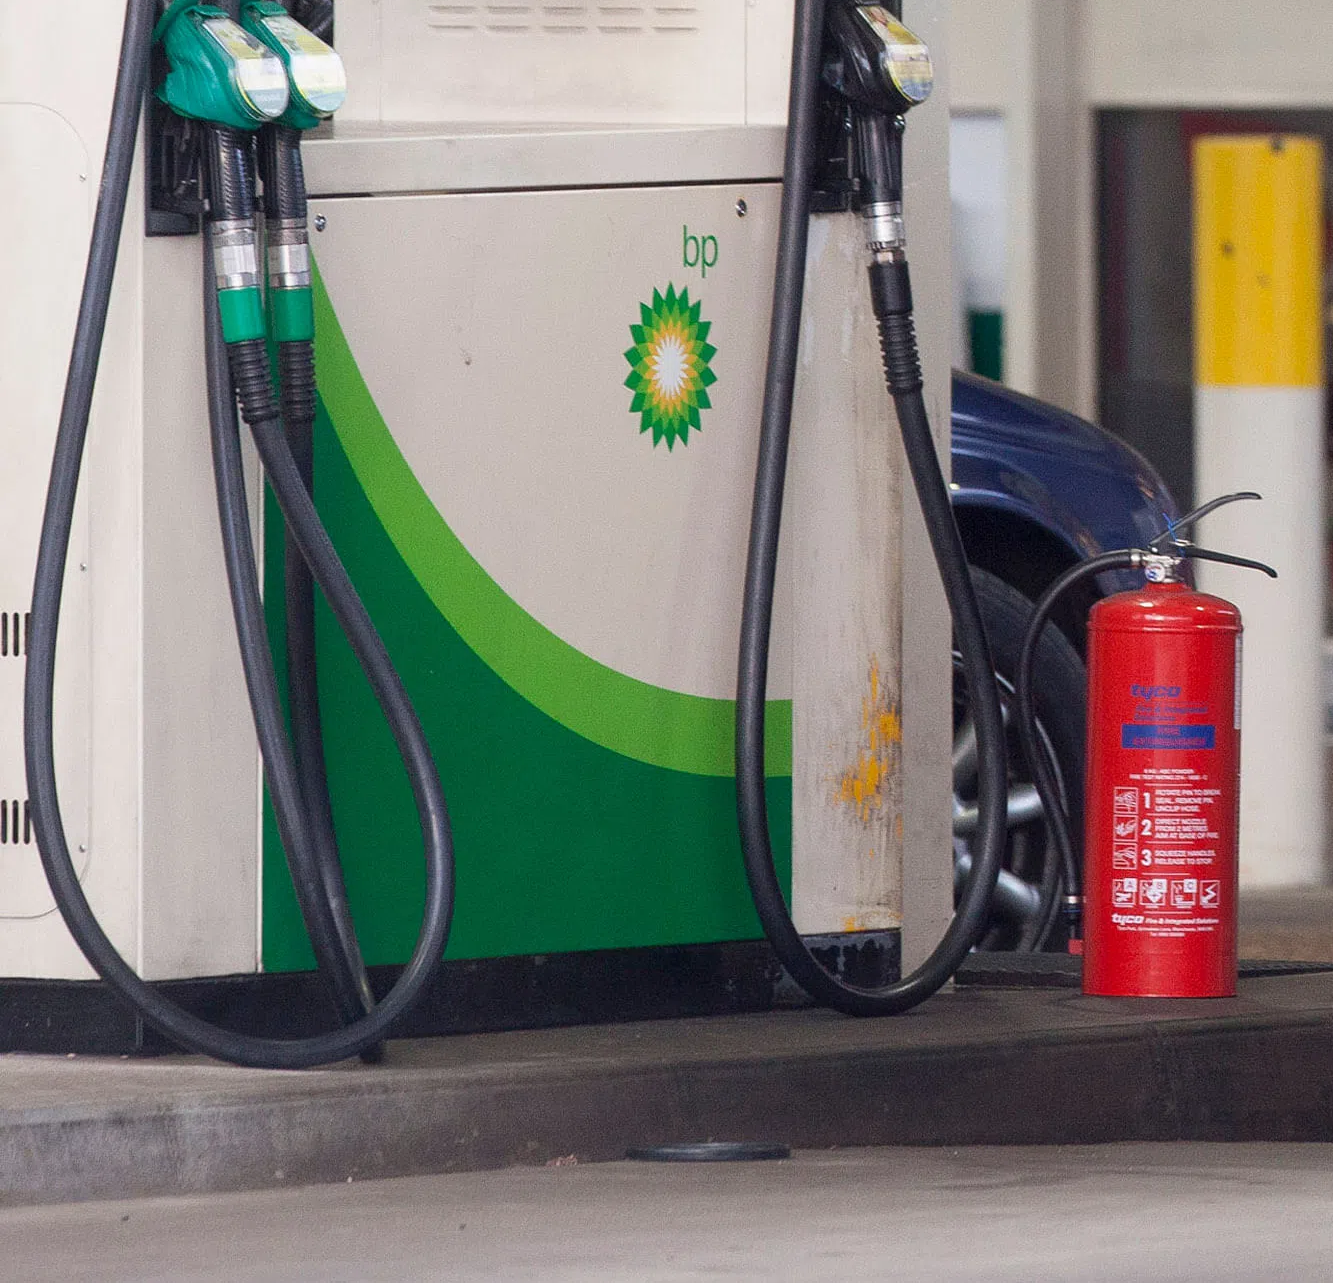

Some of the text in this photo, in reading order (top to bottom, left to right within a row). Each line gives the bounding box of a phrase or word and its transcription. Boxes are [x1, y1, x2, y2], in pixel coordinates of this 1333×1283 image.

[683, 224, 719, 279] bp
[1130, 684, 1182, 700] tyco
[1144, 792, 1151, 808] 1
[1141, 819, 1152, 836] 2
[1141, 849, 1152, 866] 3
[1111, 913, 1145, 925] tyco
